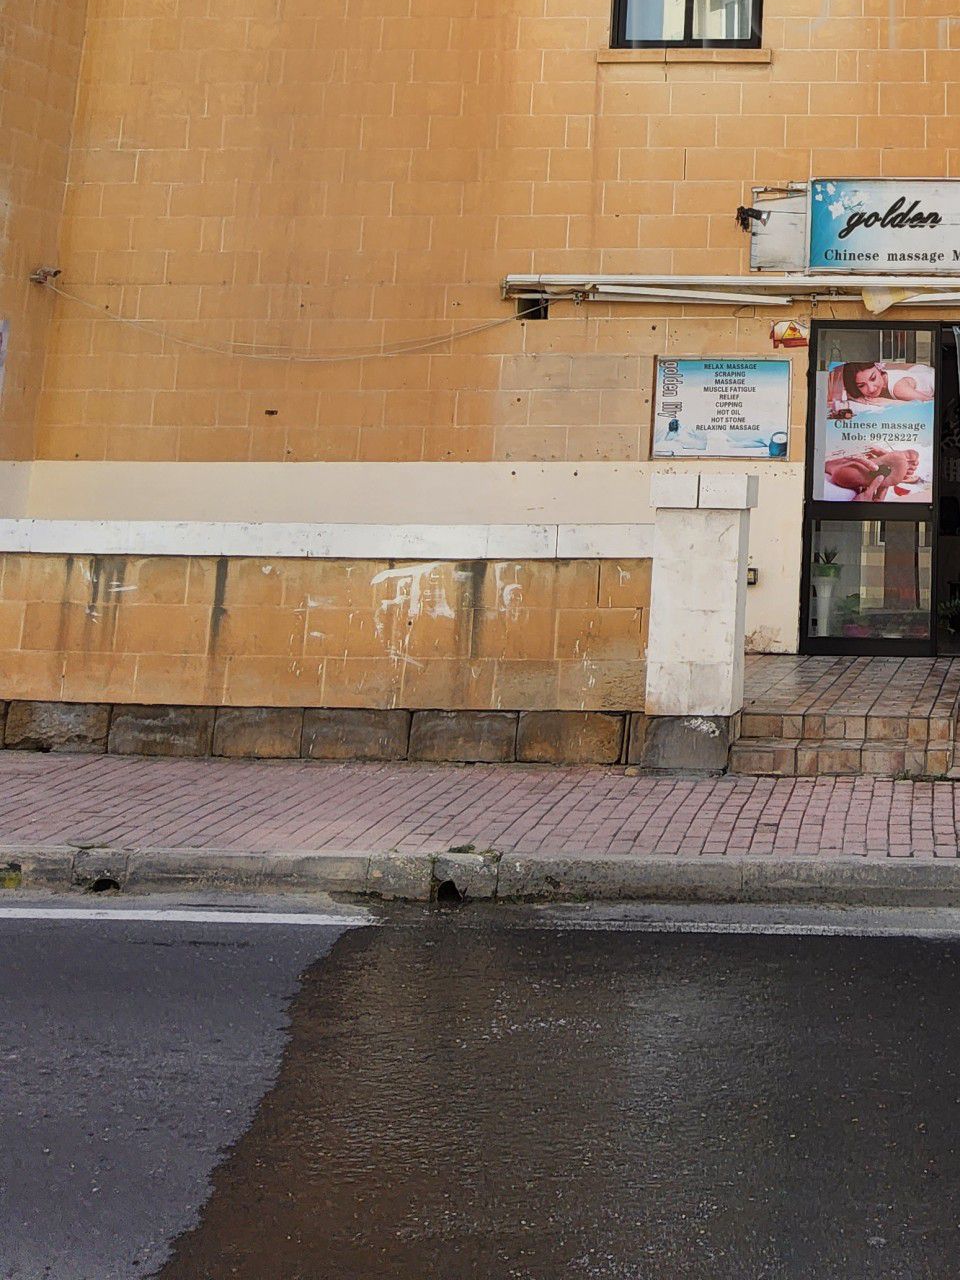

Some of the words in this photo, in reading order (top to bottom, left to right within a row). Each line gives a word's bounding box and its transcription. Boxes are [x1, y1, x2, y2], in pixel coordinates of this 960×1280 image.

[838, 196, 942, 239] golden
[824, 249, 879, 261] Chinese
[887, 250, 944, 263] massage
[659, 361, 684, 397] golden
[657, 402, 683, 419] lily
[834, 420, 877, 429] Chinese
[881, 422, 926, 431] massage
[841, 433, 866, 441] Mob:
[870, 433, 919, 442] 99728227
